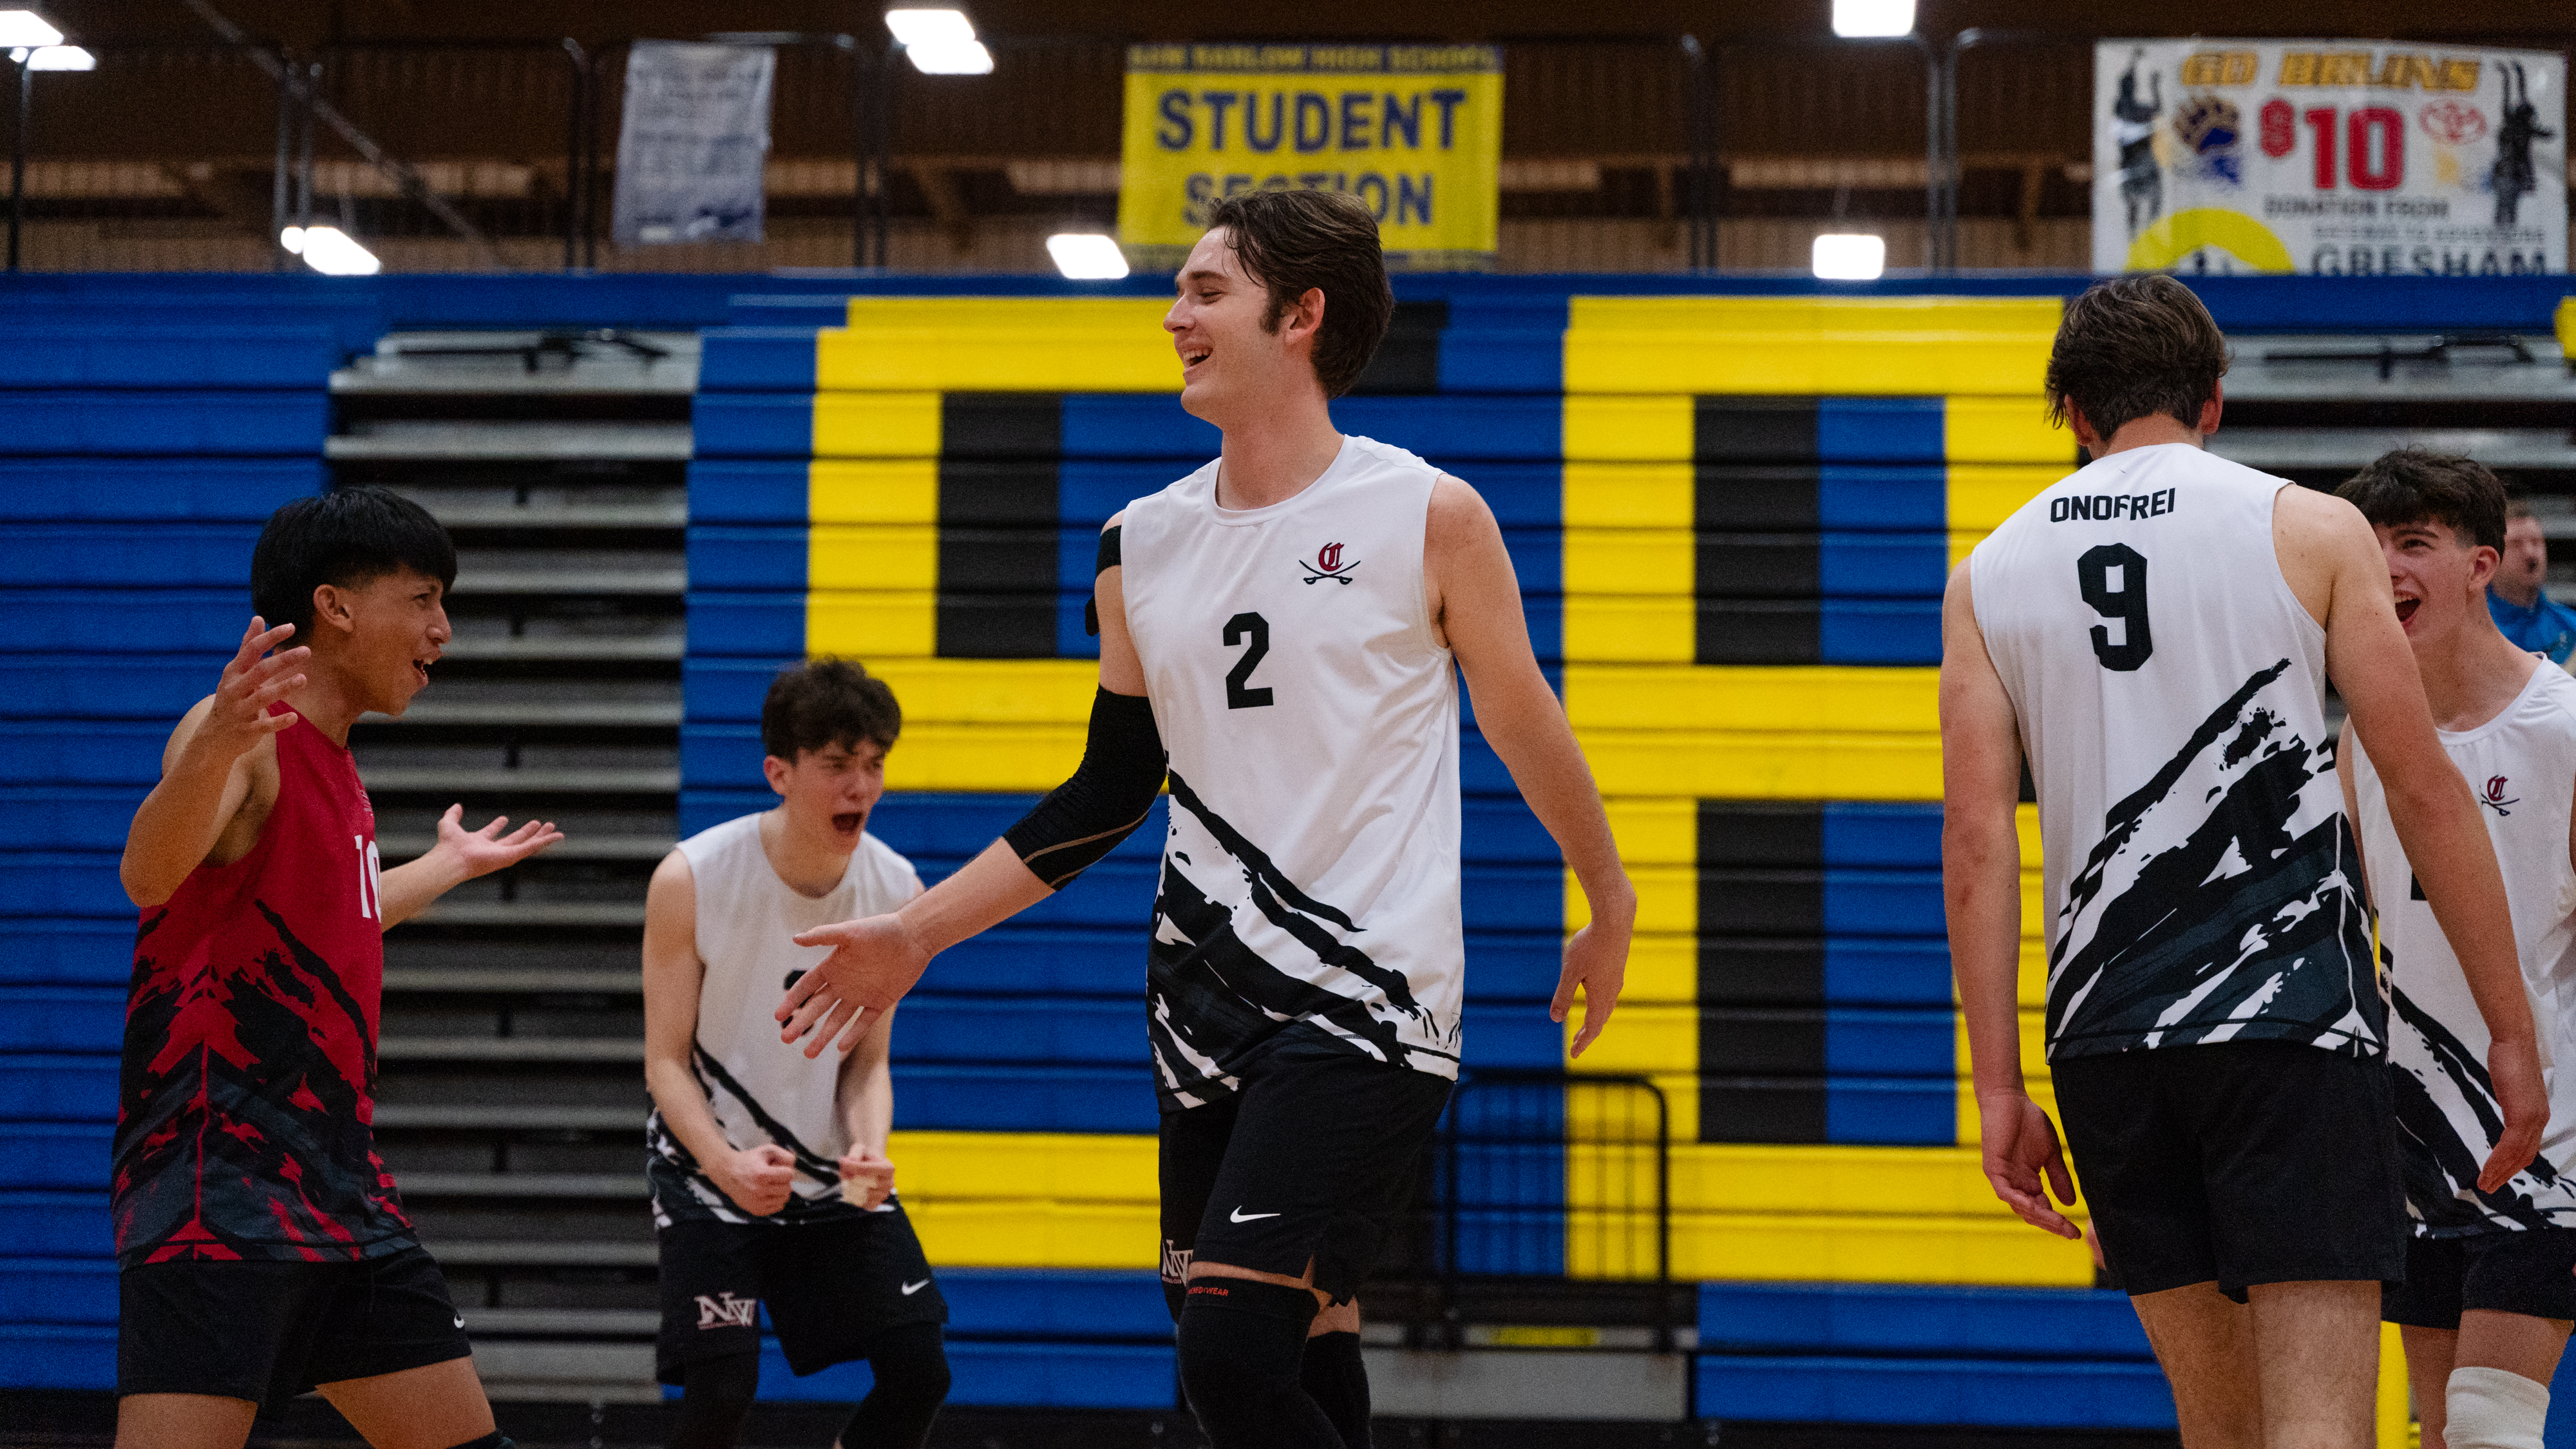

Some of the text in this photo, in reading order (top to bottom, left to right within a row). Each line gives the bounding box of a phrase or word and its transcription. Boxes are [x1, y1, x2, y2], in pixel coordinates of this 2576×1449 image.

[1156, 89, 1468, 154] STUDENT
[2050, 488, 2175, 523] ONOFREI
[2078, 542, 2153, 672] 9
[1223, 611, 1274, 709] 2
